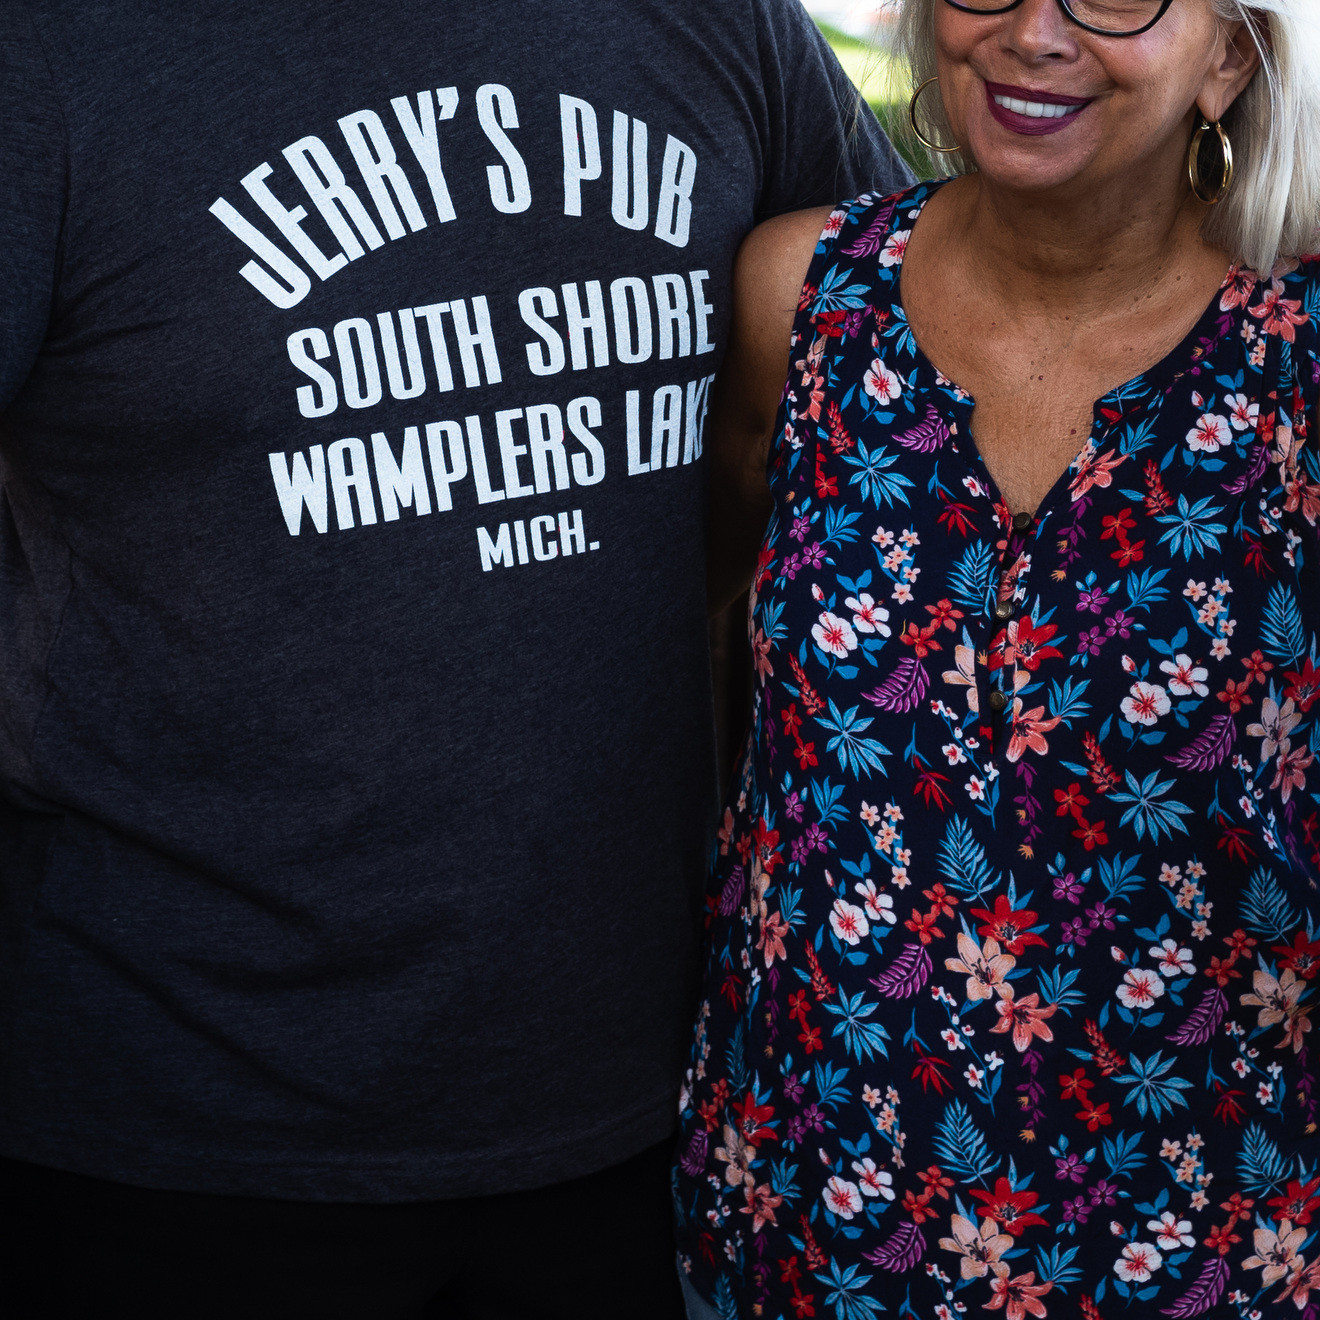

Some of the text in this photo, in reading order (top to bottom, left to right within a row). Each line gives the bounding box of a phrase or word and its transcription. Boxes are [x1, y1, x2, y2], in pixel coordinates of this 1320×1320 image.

[208, 83, 698, 309] JERRY'S PUB
[286, 269, 716, 418] SOUTH SHORE
[268, 396, 606, 536] WAMPLERS
[477, 509, 600, 572] MICH.
